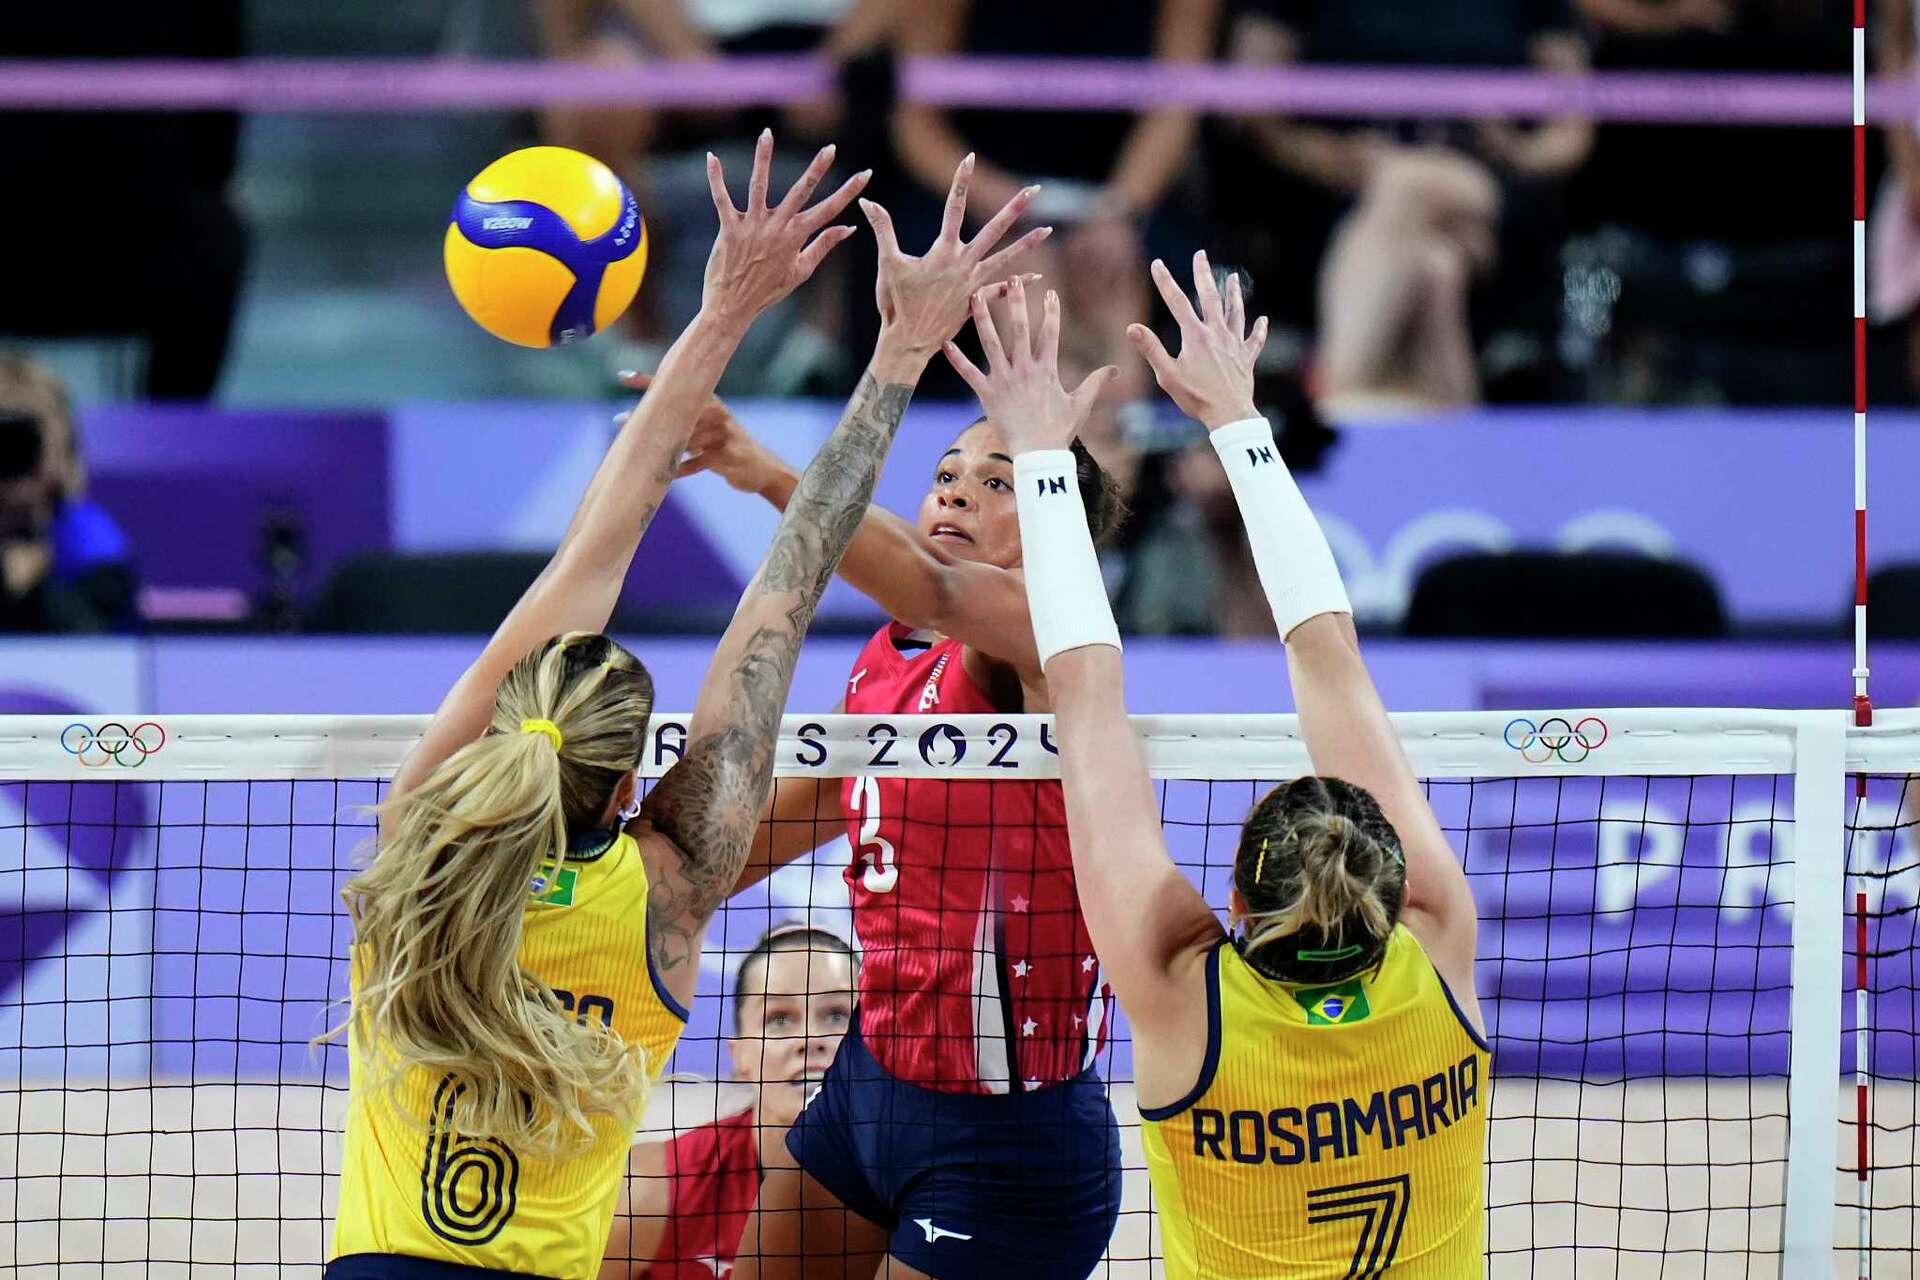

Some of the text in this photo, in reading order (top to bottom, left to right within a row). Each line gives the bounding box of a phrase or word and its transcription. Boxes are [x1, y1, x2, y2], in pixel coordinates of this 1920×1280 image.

[421, 1071, 533, 1246] 6
[1191, 1053, 1479, 1166] ROSAMARIA
[1306, 1173, 1411, 1280] 7
